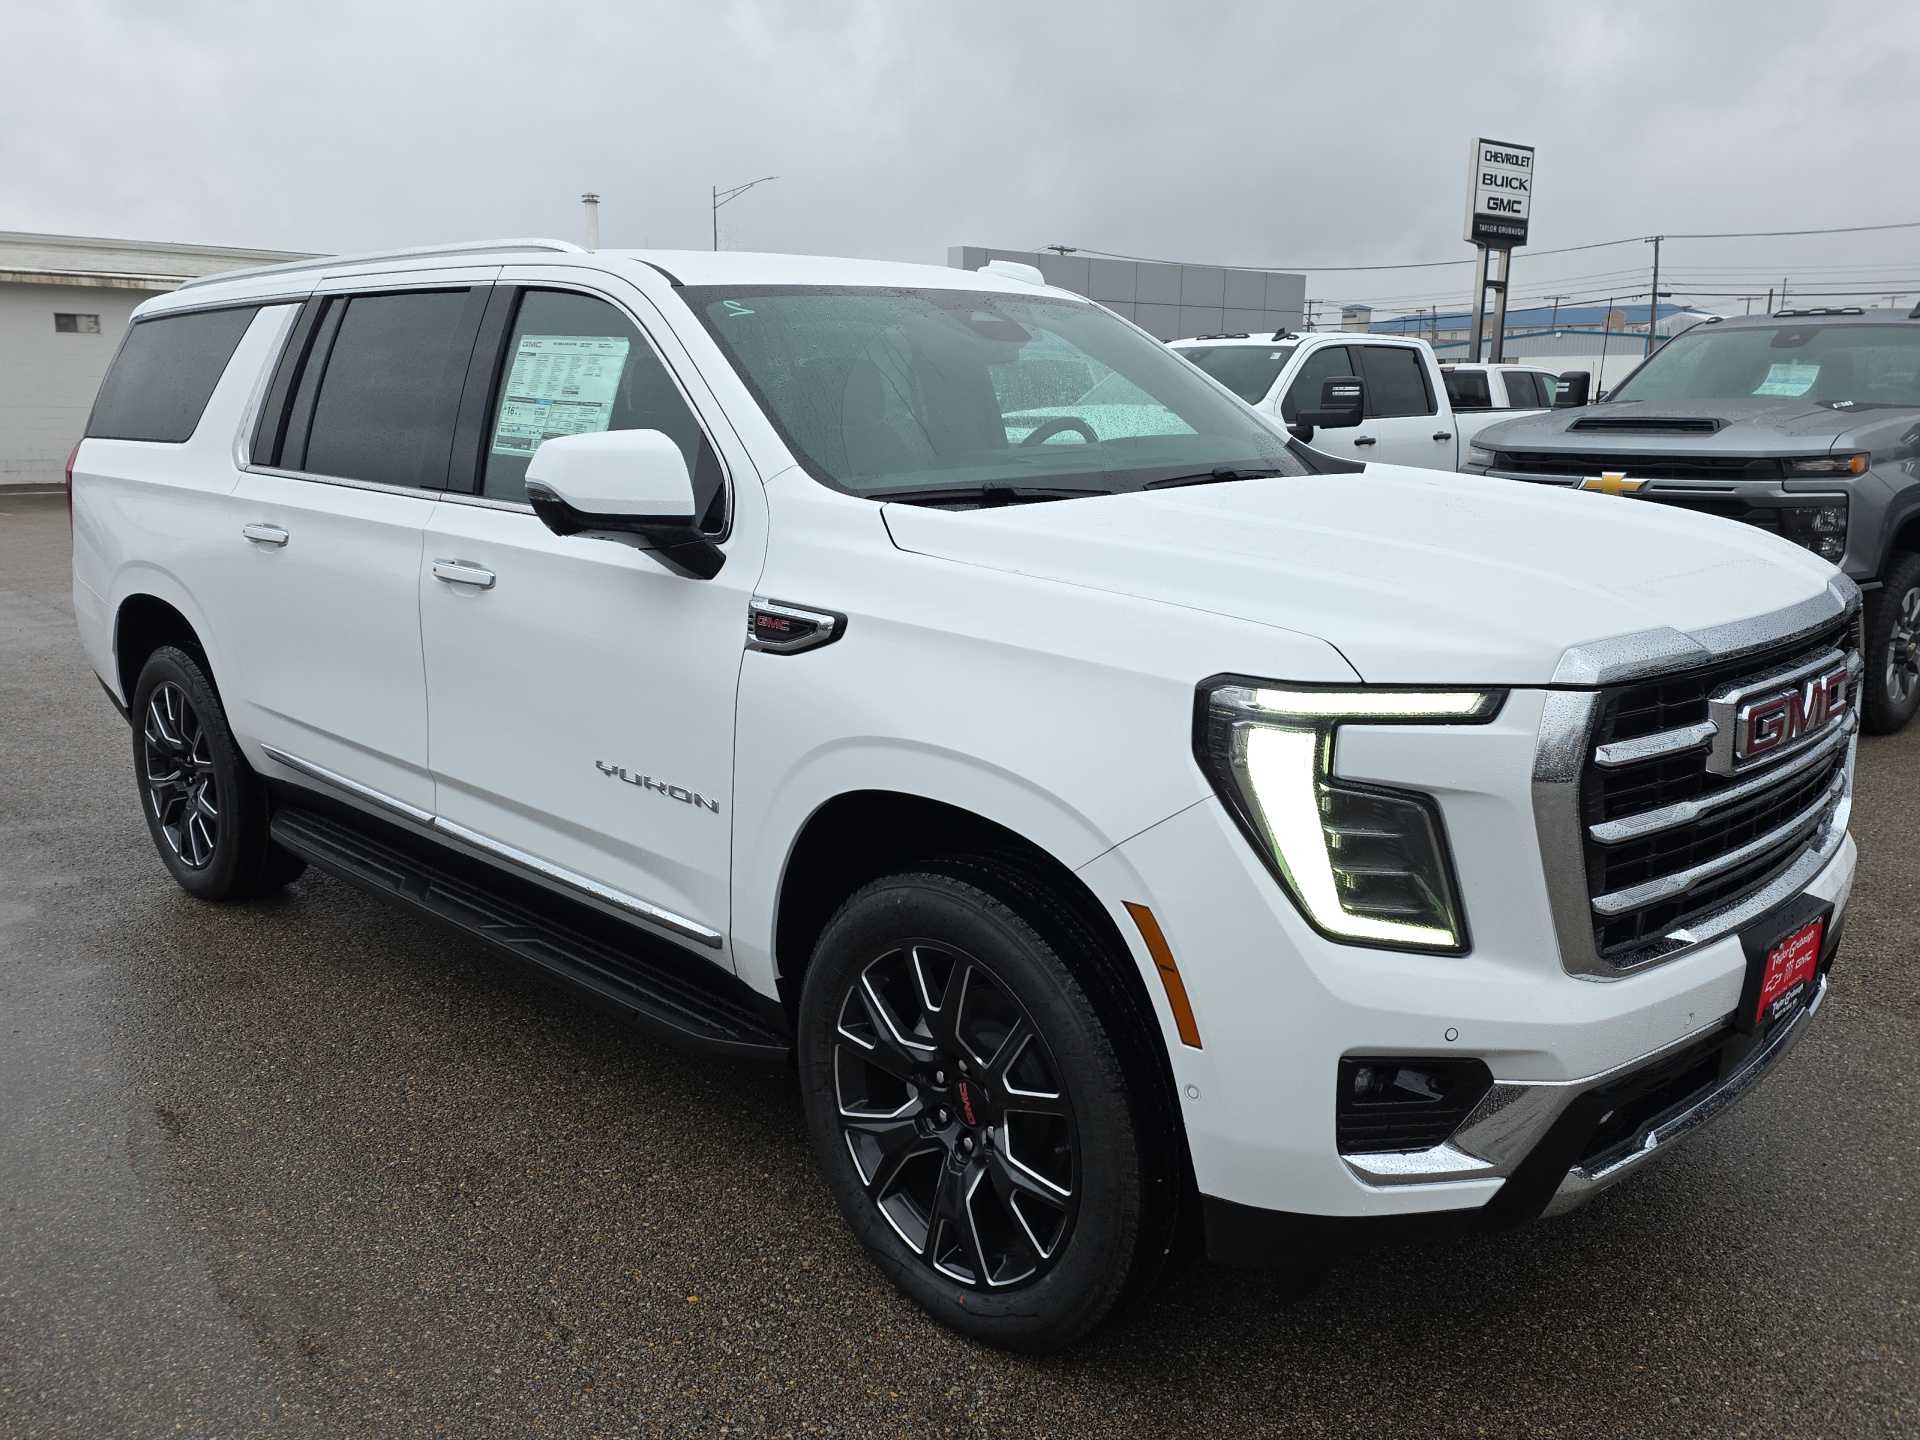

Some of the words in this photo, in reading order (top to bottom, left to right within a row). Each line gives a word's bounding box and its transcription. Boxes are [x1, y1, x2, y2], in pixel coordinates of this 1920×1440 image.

[1484, 150, 1531, 168] CHEVROLET
[1482, 173, 1529, 191] BUICK
[1487, 196, 1522, 213] GMC
[1479, 224, 1497, 233] TAYLOR
[1498, 226, 1525, 236] GRUBAUGH
[507, 406, 515, 415] 16
[757, 615, 791, 632] GMC
[1738, 666, 1848, 759] GMC
[595, 760, 720, 815] YUKON
[1795, 950, 1814, 970] GMC
[958, 1082, 976, 1125] GMC
